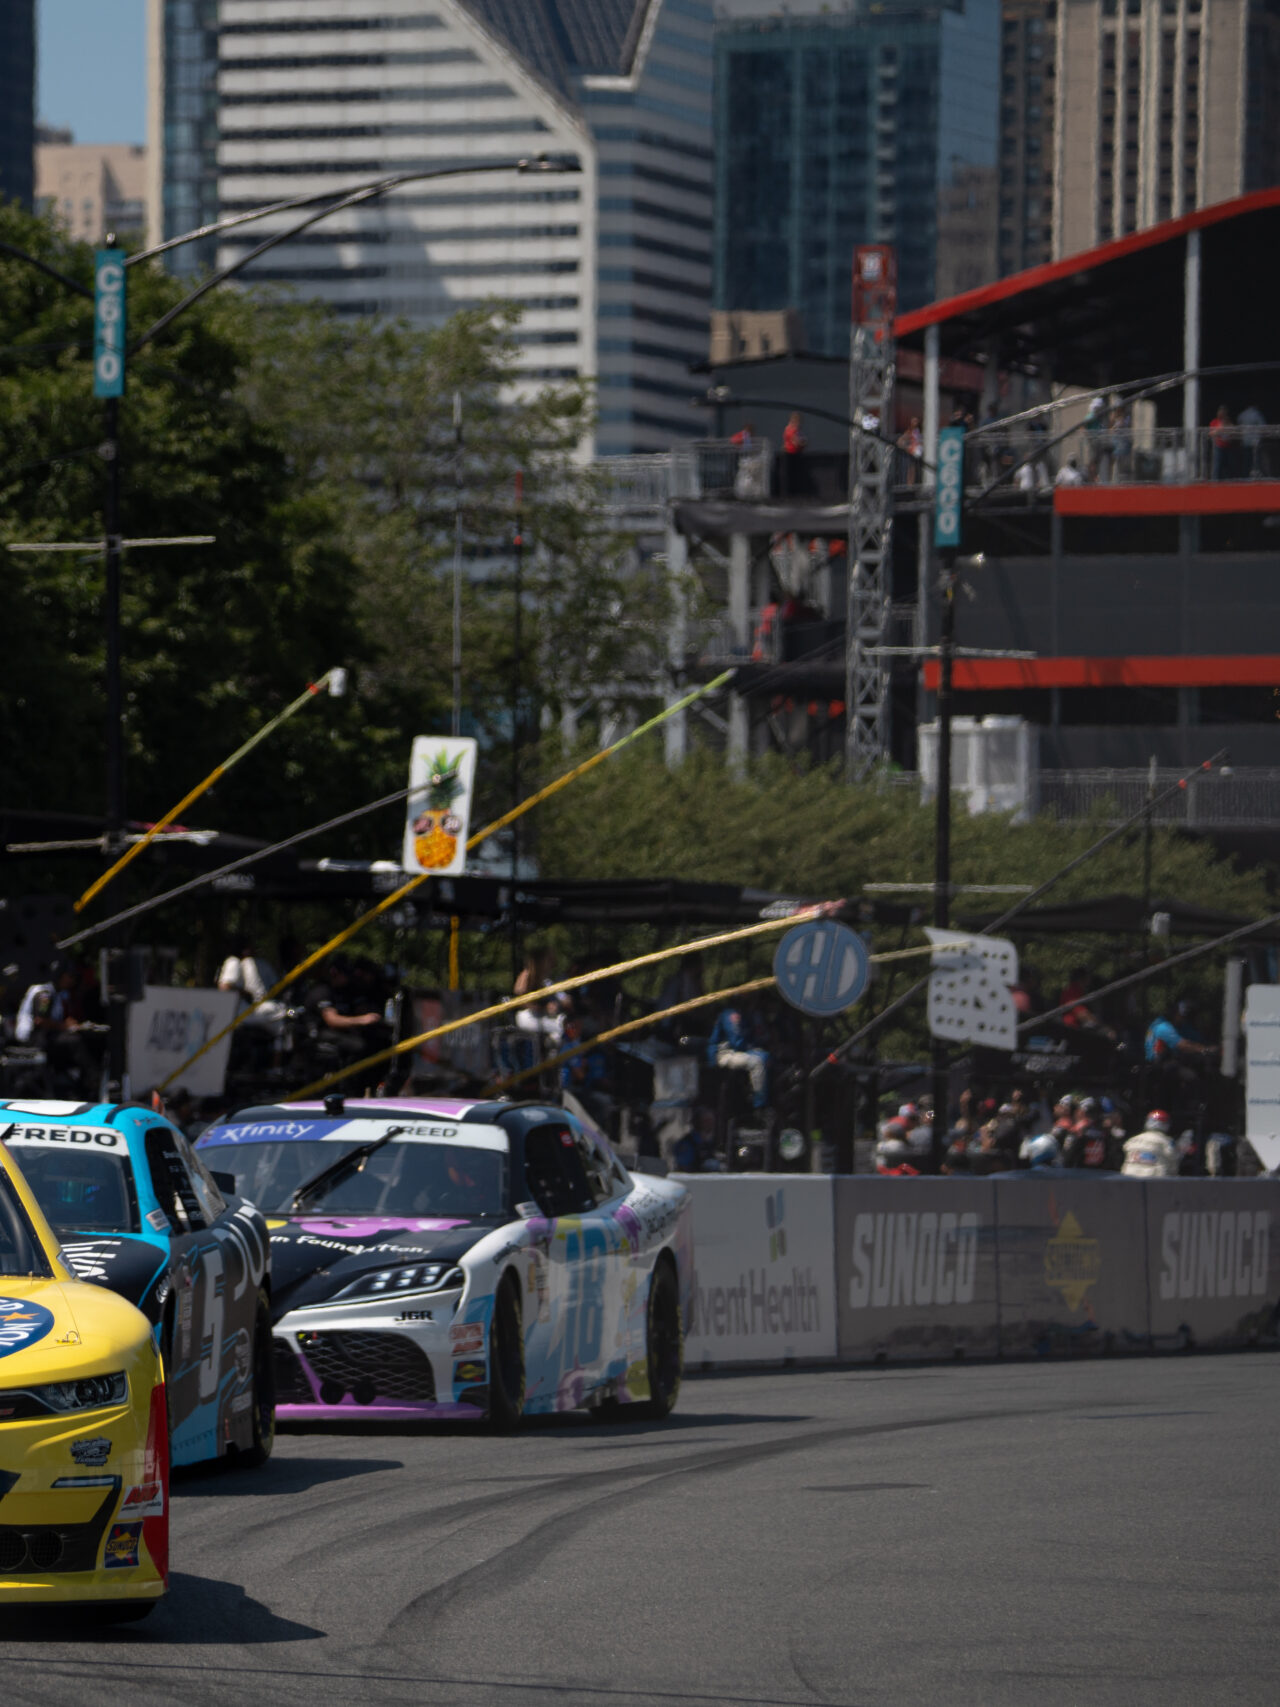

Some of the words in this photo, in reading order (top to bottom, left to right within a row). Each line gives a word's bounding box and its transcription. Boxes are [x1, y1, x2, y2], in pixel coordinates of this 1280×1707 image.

[96, 264, 123, 383] C610
[221, 1122, 315, 1142] xfinity
[850, 1212, 980, 1308] SUNOCO
[1160, 1211, 1269, 1299] SUNOCO
[395, 1311, 433, 1321] JGR
